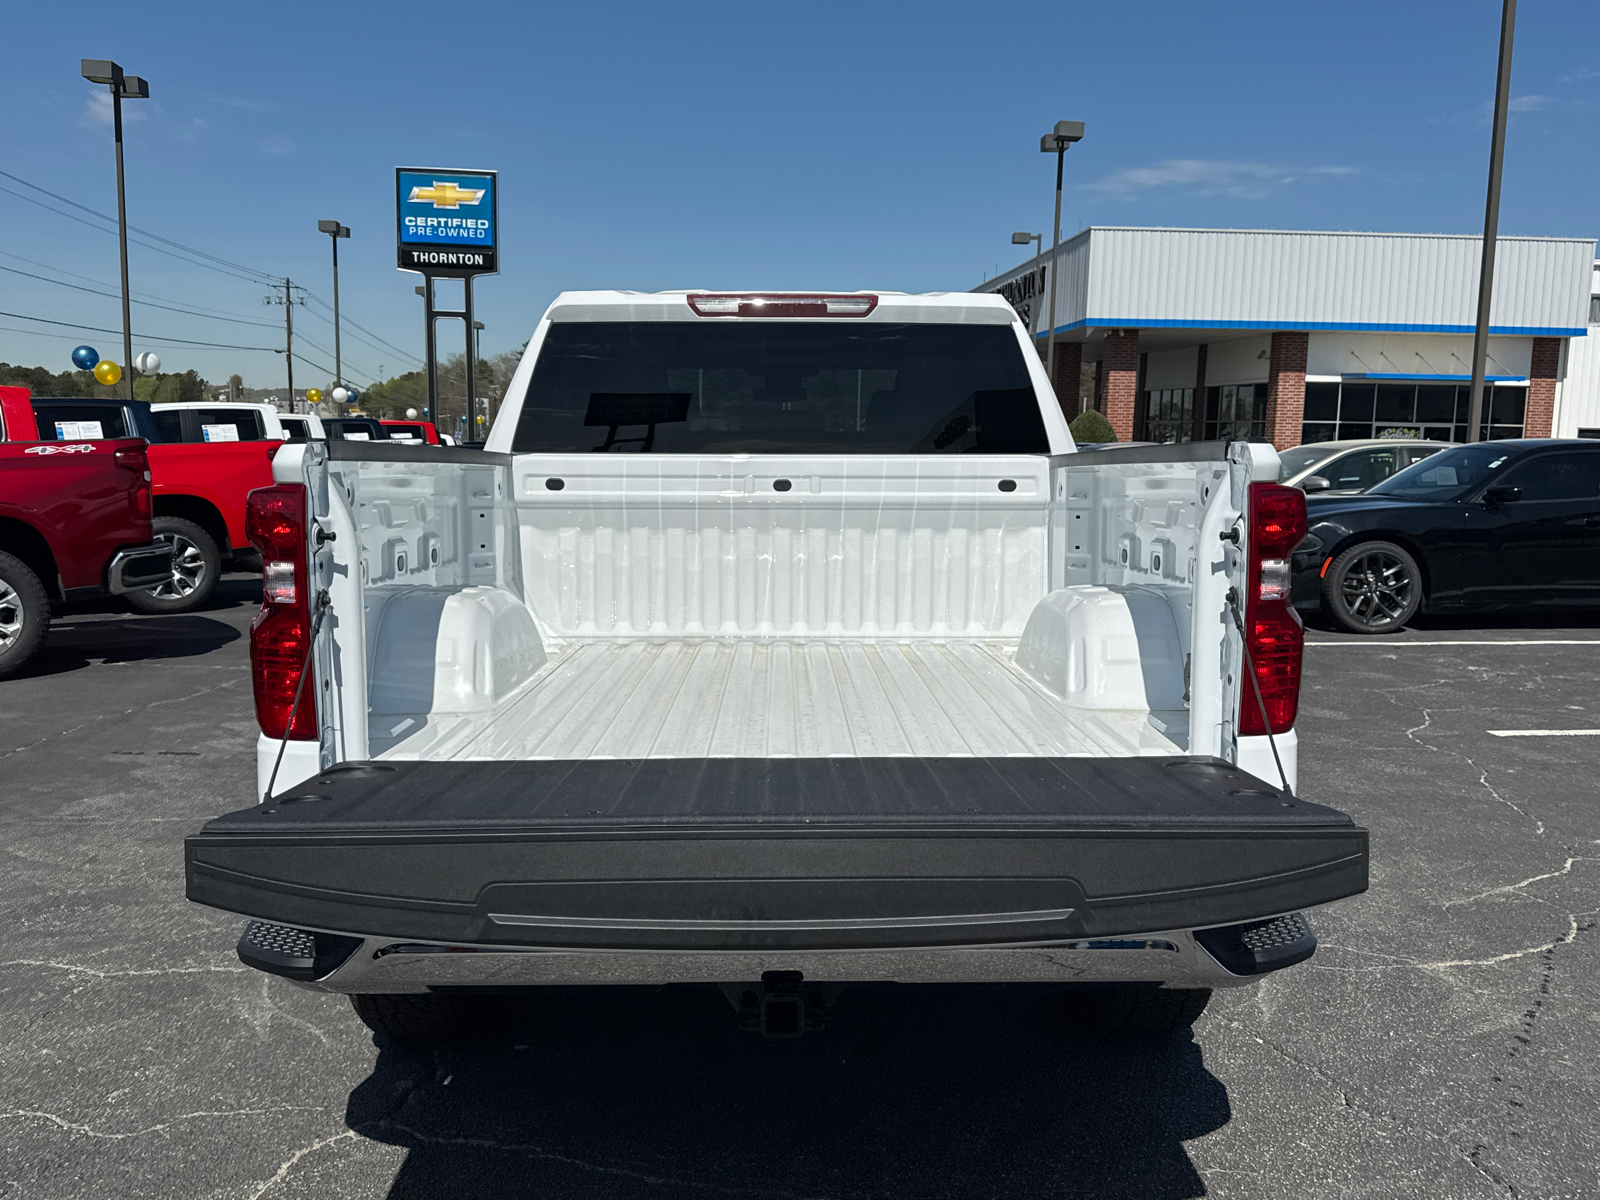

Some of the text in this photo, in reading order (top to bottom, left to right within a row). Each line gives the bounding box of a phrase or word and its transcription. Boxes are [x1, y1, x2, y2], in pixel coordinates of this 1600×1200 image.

[404, 216, 489, 229] CERTIFIED
[409, 226, 485, 238] PRE-OWNED
[412, 251, 484, 265] THORNTON
